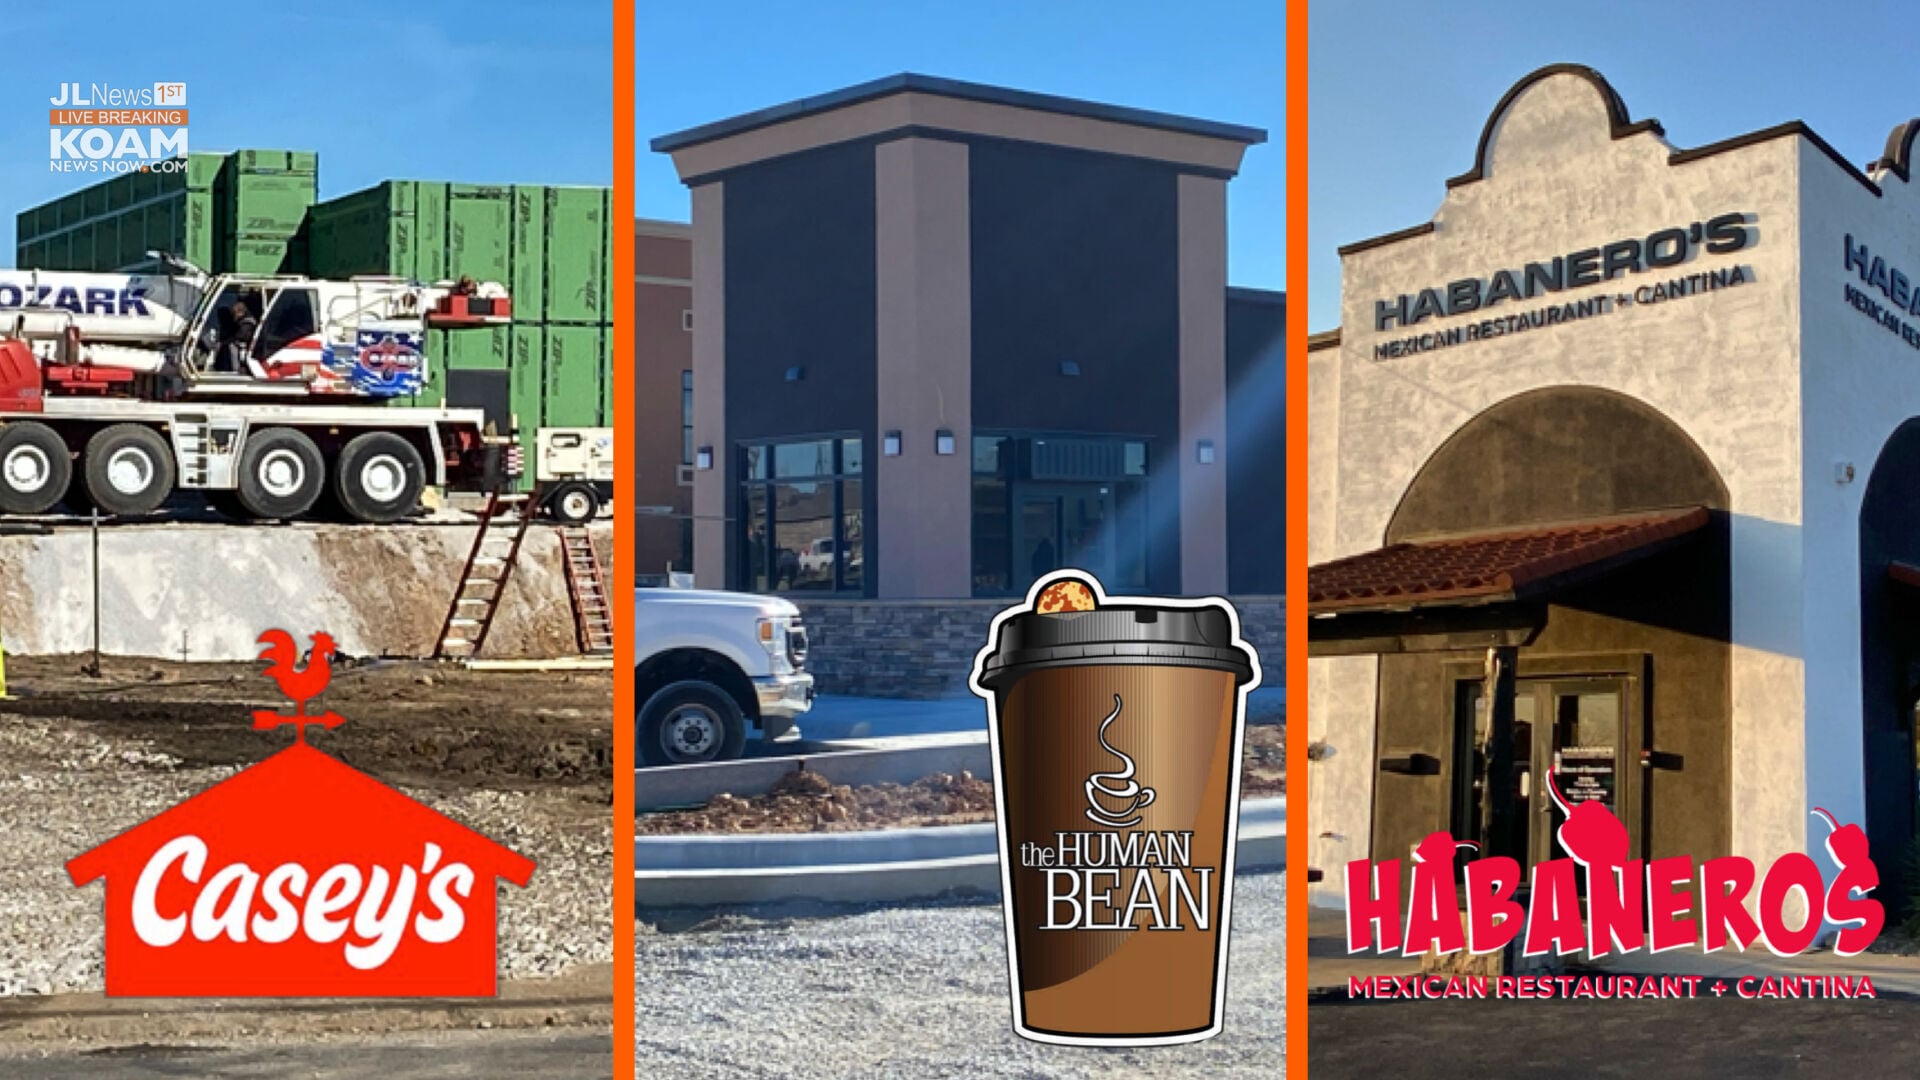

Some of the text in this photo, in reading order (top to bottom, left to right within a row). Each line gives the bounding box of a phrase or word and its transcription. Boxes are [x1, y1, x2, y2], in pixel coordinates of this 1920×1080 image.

[0, 283, 149, 316] OZARK
[1374, 325, 1460, 360] MEXICAN
[1466, 296, 1607, 342] RESTAURANT
[1634, 265, 1745, 304] CANTINA
[1375, 212, 1748, 331] HABANERO'S
